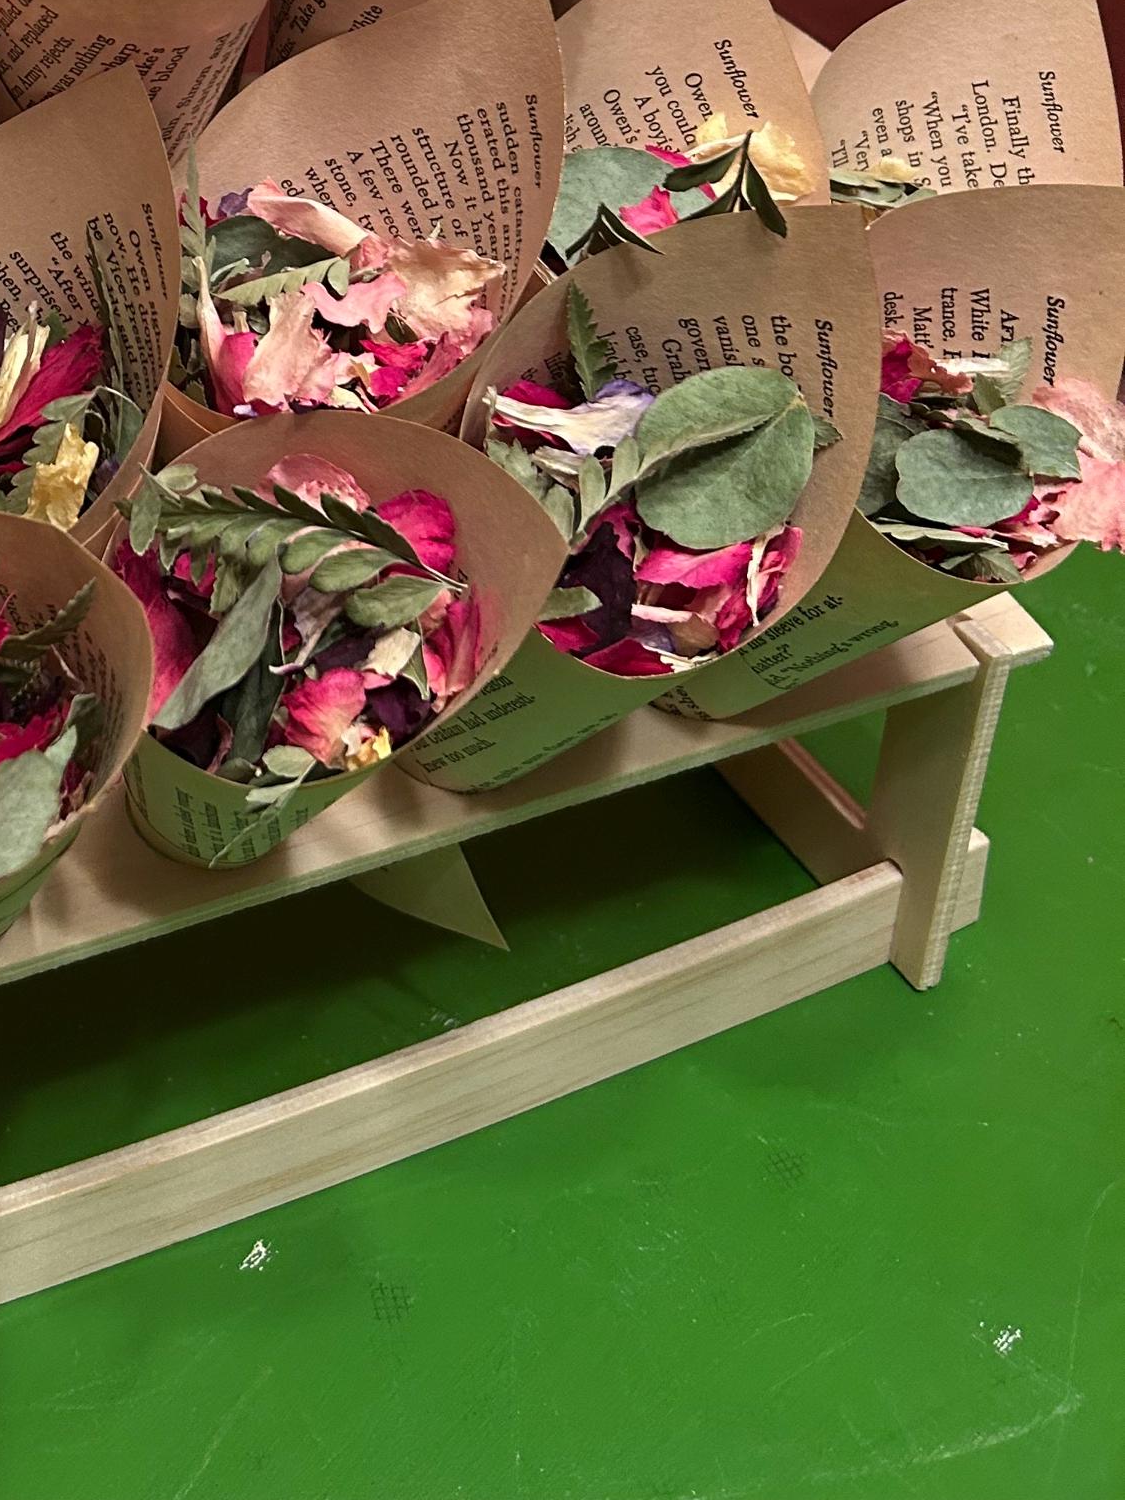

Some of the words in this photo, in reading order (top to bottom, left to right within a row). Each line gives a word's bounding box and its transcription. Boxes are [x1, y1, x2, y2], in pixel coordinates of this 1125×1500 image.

[67, 33, 116, 77] nothing
[644, 65, 673, 98] you
[713, 39, 760, 119] Sunflower
[495, 101, 520, 176] sudden
[524, 93, 543, 189] Sunflower
[871, 107, 889, 144] even
[895, 99, 916, 143] shops
[907, 151, 924, 168] in
[971, 79, 999, 153] London.
[1001, 95, 1030, 159] Finally
[1038, 71, 1065, 154] Sunflower
[324, 158, 357, 208] stone,
[369, 139, 403, 194] There
[389, 134, 440, 211] rounded
[411, 127, 456, 210] structure
[451, 218, 469, 238] of
[443, 139, 469, 186] Now
[463, 196, 478, 212] it
[456, 113, 496, 204] thousand
[930, 155, 952, 188] you
[50, 231, 73, 261] the
[87, 216, 104, 241] be
[741, 314, 761, 348] one
[770, 314, 793, 347] the
[883, 291, 905, 329] desk.
[940, 287, 959, 342] trance.
[970, 288, 992, 342] White
[814, 318, 839, 418] Sunflower
[1041, 295, 1066, 389] Sunflower
